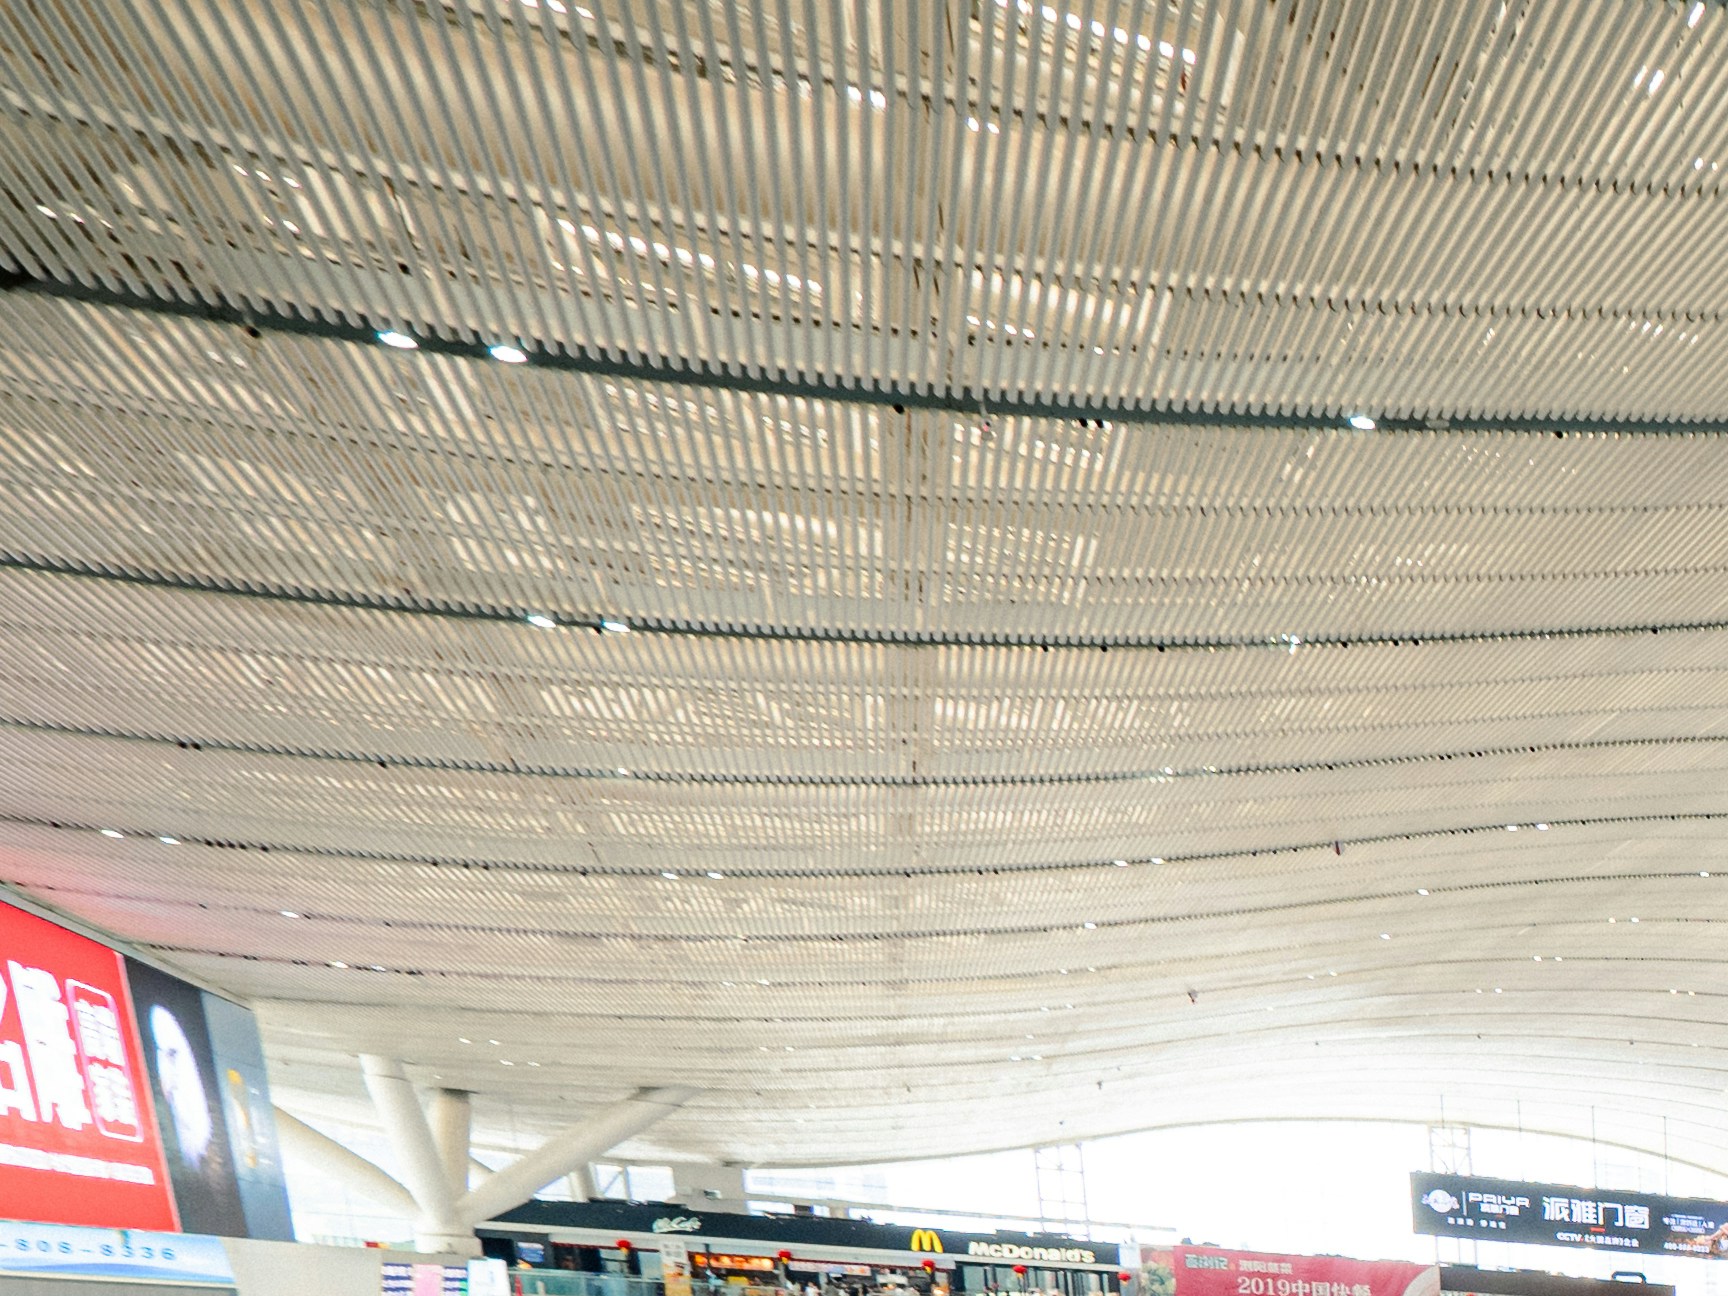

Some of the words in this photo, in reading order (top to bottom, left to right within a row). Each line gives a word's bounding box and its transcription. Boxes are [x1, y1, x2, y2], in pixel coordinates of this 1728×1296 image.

[1541, 1195, 1650, 1230] 派雅门窗
[968, 1240, 1097, 1265] McDonald's
